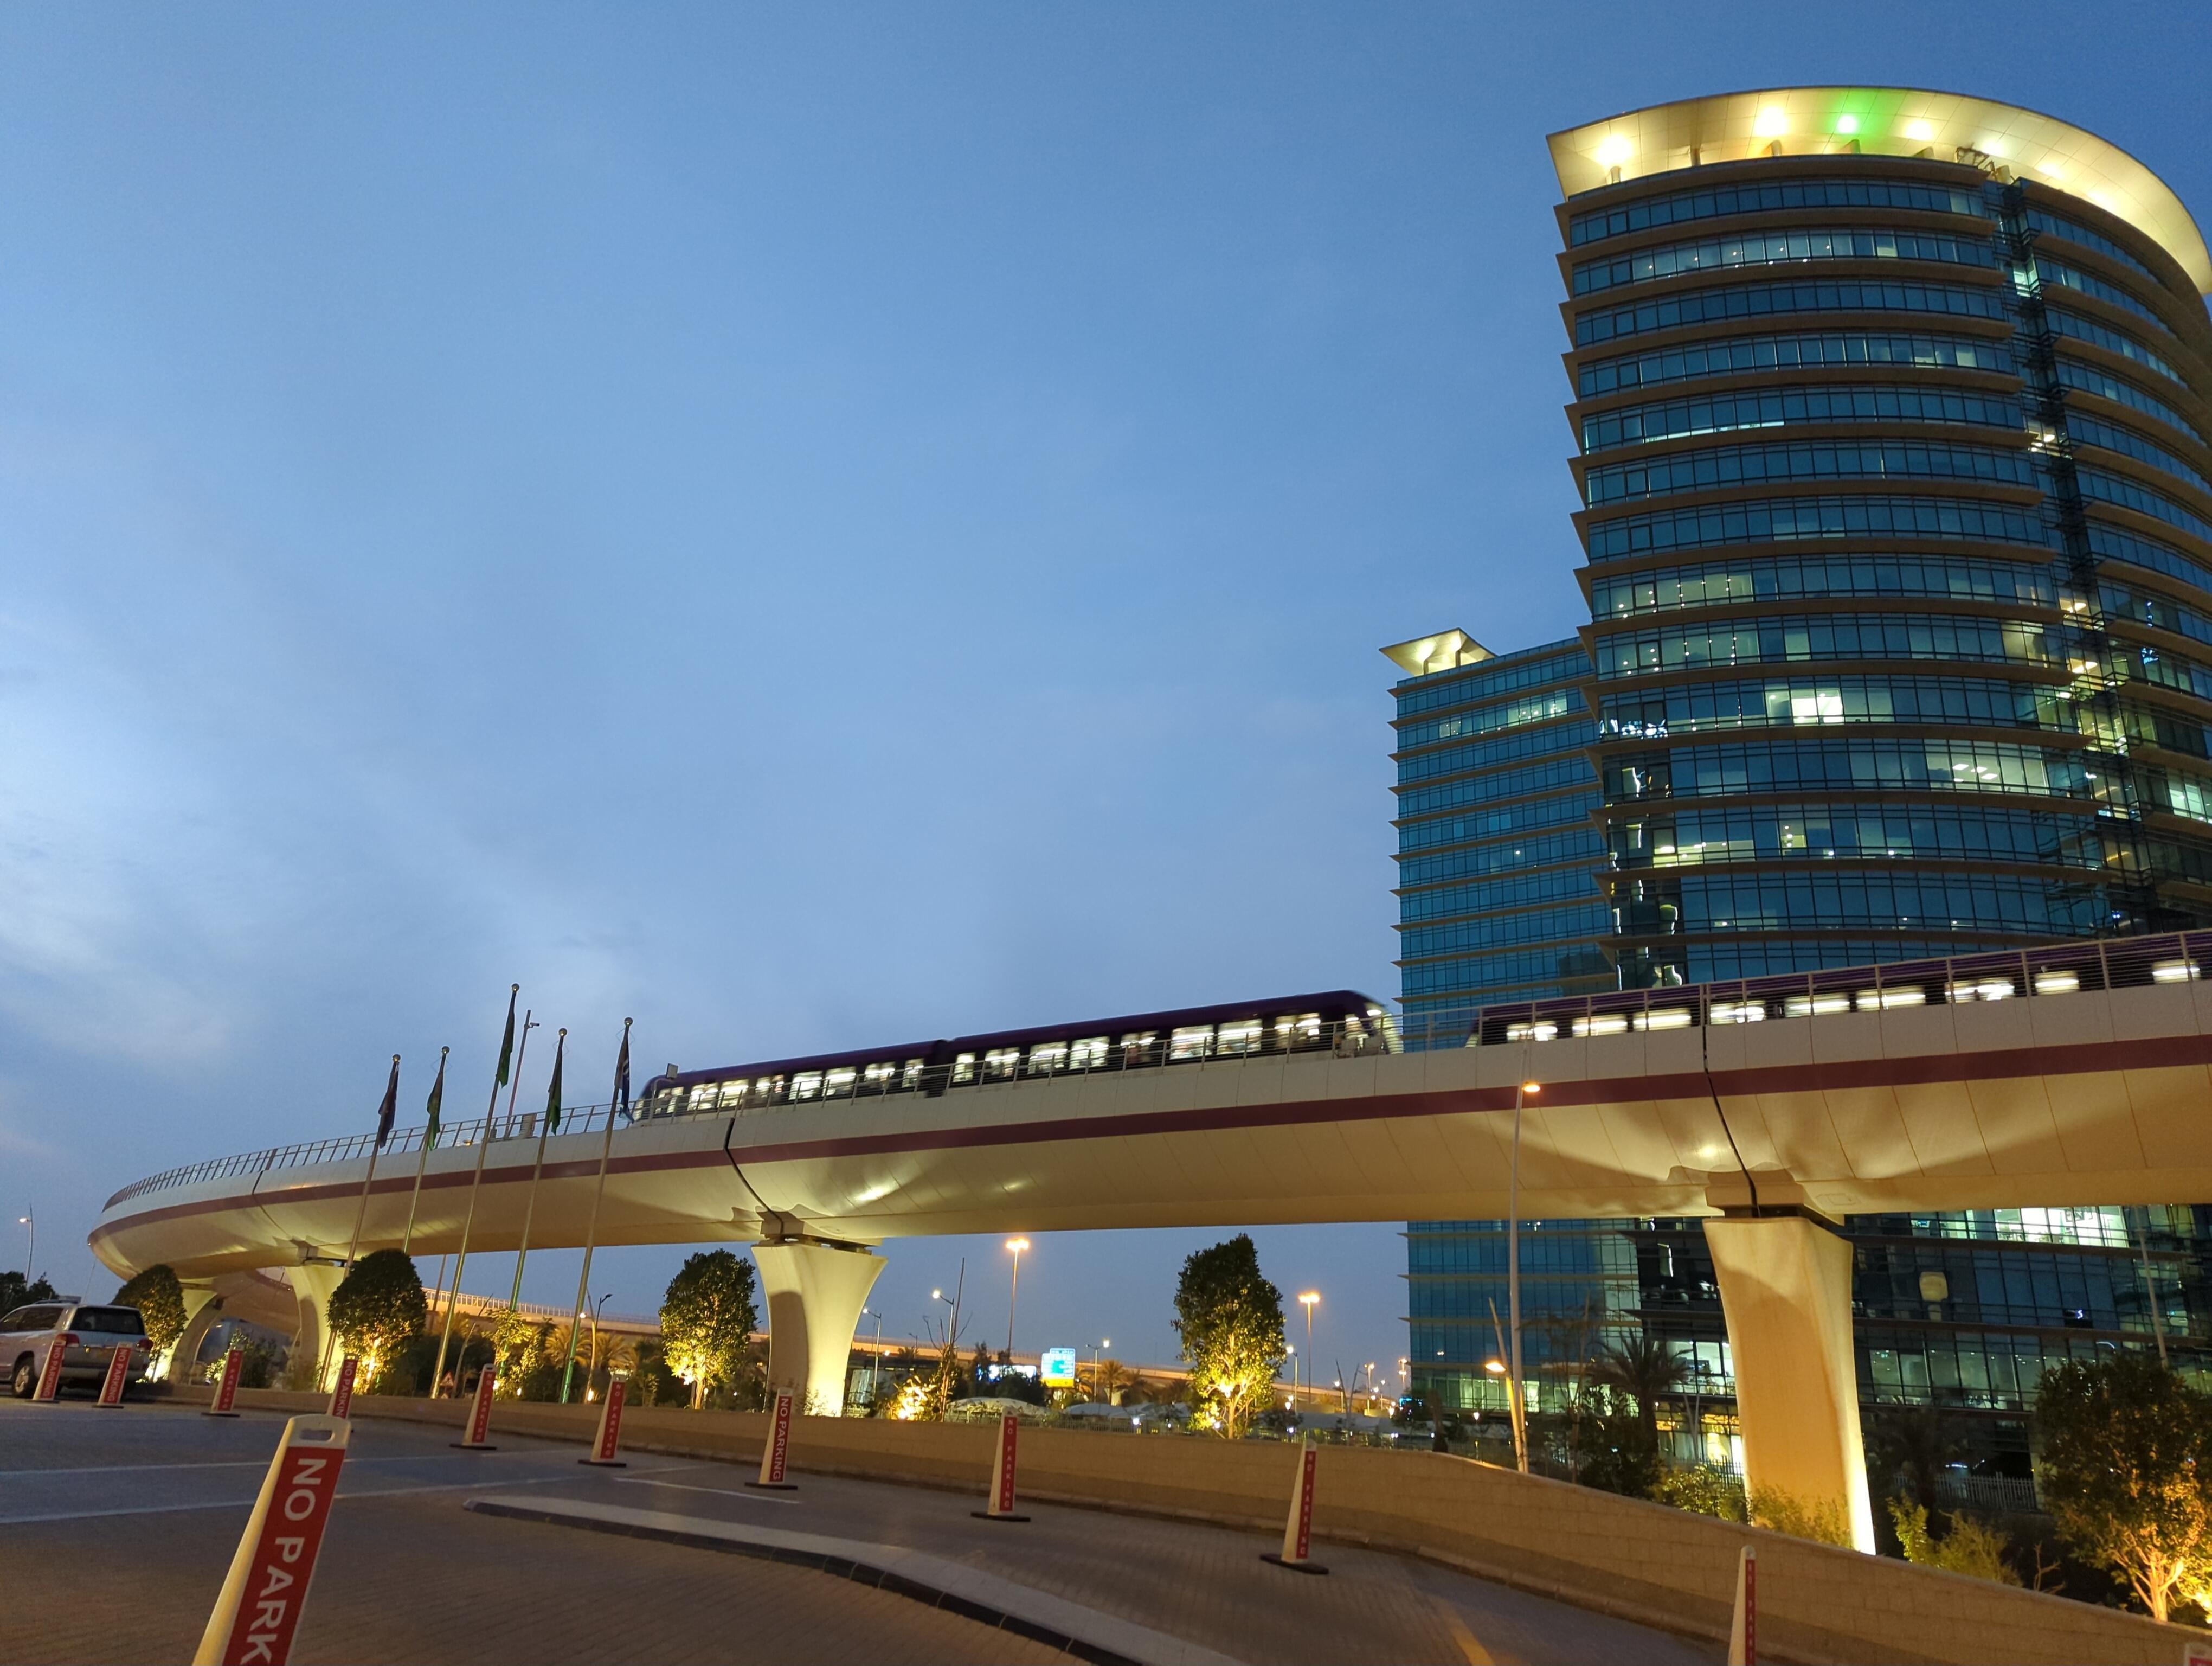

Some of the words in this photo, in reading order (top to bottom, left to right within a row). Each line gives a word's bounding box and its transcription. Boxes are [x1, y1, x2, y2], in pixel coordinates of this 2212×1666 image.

[54, 1347, 61, 1359] NO
[119, 1349, 127, 1361] NO
[44, 1361, 58, 1396] PARKING
[345, 1362, 353, 1376] NO
[486, 1373, 493, 1385] NO
[107, 1364, 124, 1402] PARKING
[615, 1384, 621, 1396] NO
[476, 1393, 489, 1440] PARKING
[780, 1398, 789, 1417] NO
[605, 1406, 618, 1456] PARKING
[1007, 1419, 1013, 1434] NO
[773, 1421, 786, 1480] PARKING
[1307, 1454, 1313, 1471] NO
[284, 1458, 327, 1521] NO
[1004, 1446, 1012, 1507] PARKING
[1300, 1485, 1310, 1554] PARKING
